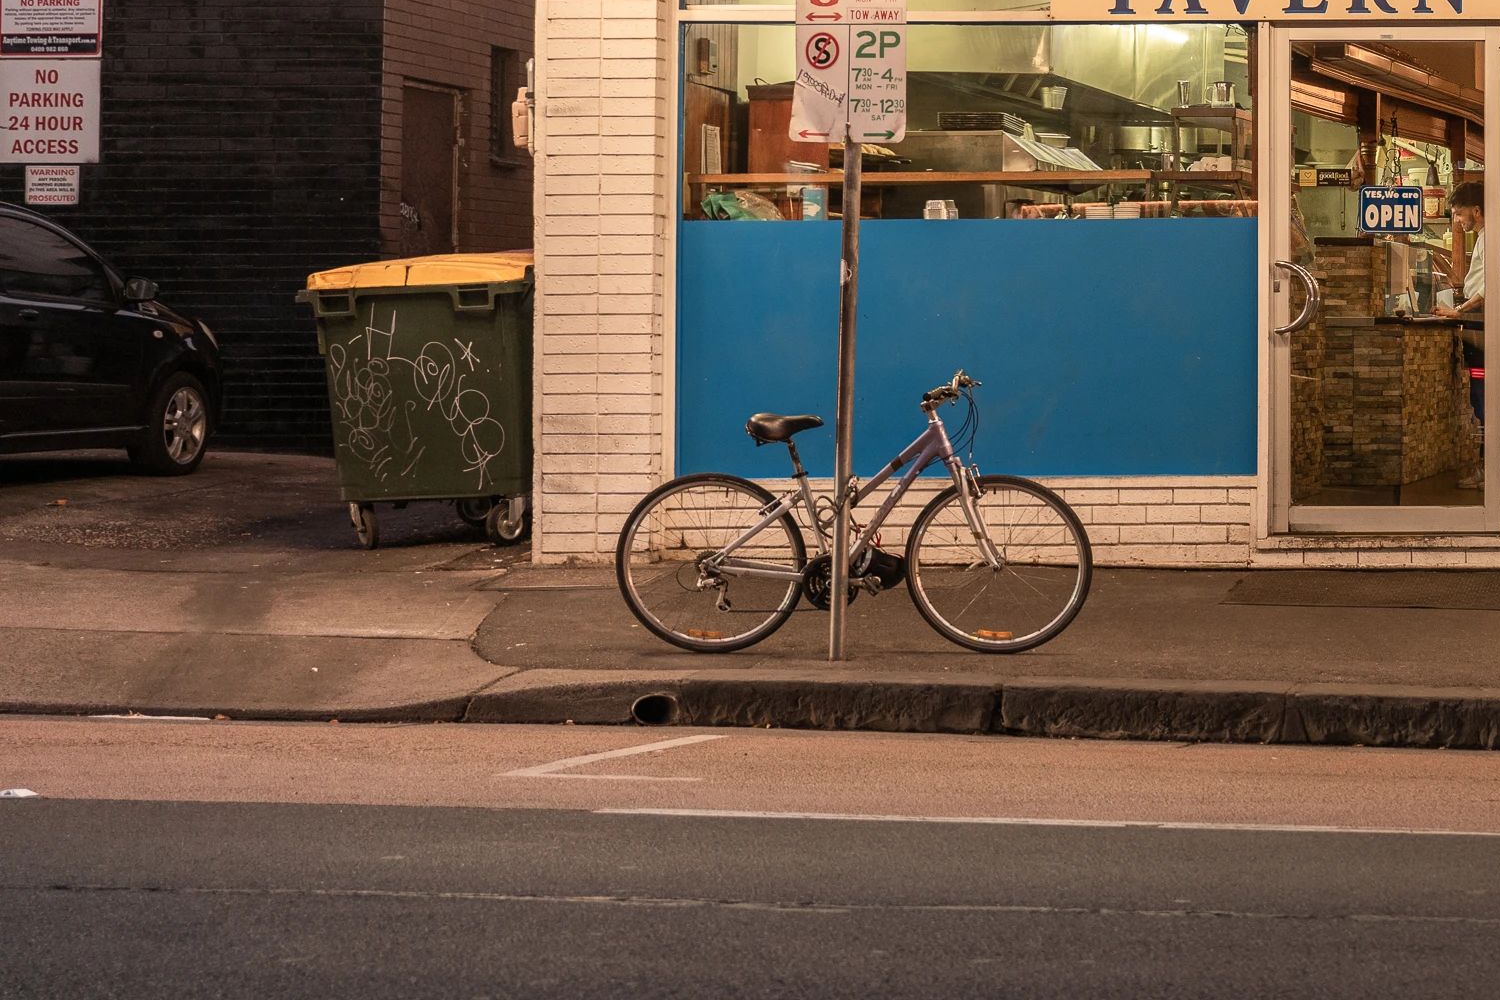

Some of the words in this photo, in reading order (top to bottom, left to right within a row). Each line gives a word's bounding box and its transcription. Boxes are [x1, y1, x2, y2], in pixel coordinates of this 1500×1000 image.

[850, 10, 870, 20] TOW
[874, 10, 899, 20] AWAY
[855, 30, 901, 59] 2P
[35, 69, 59, 84] NO
[9, 92, 84, 108] PARKING
[8, 116, 30, 131] 24
[35, 116, 83, 131] HOUR
[11, 139, 78, 154] ACCESS
[1365, 204, 1419, 228] OPEN
